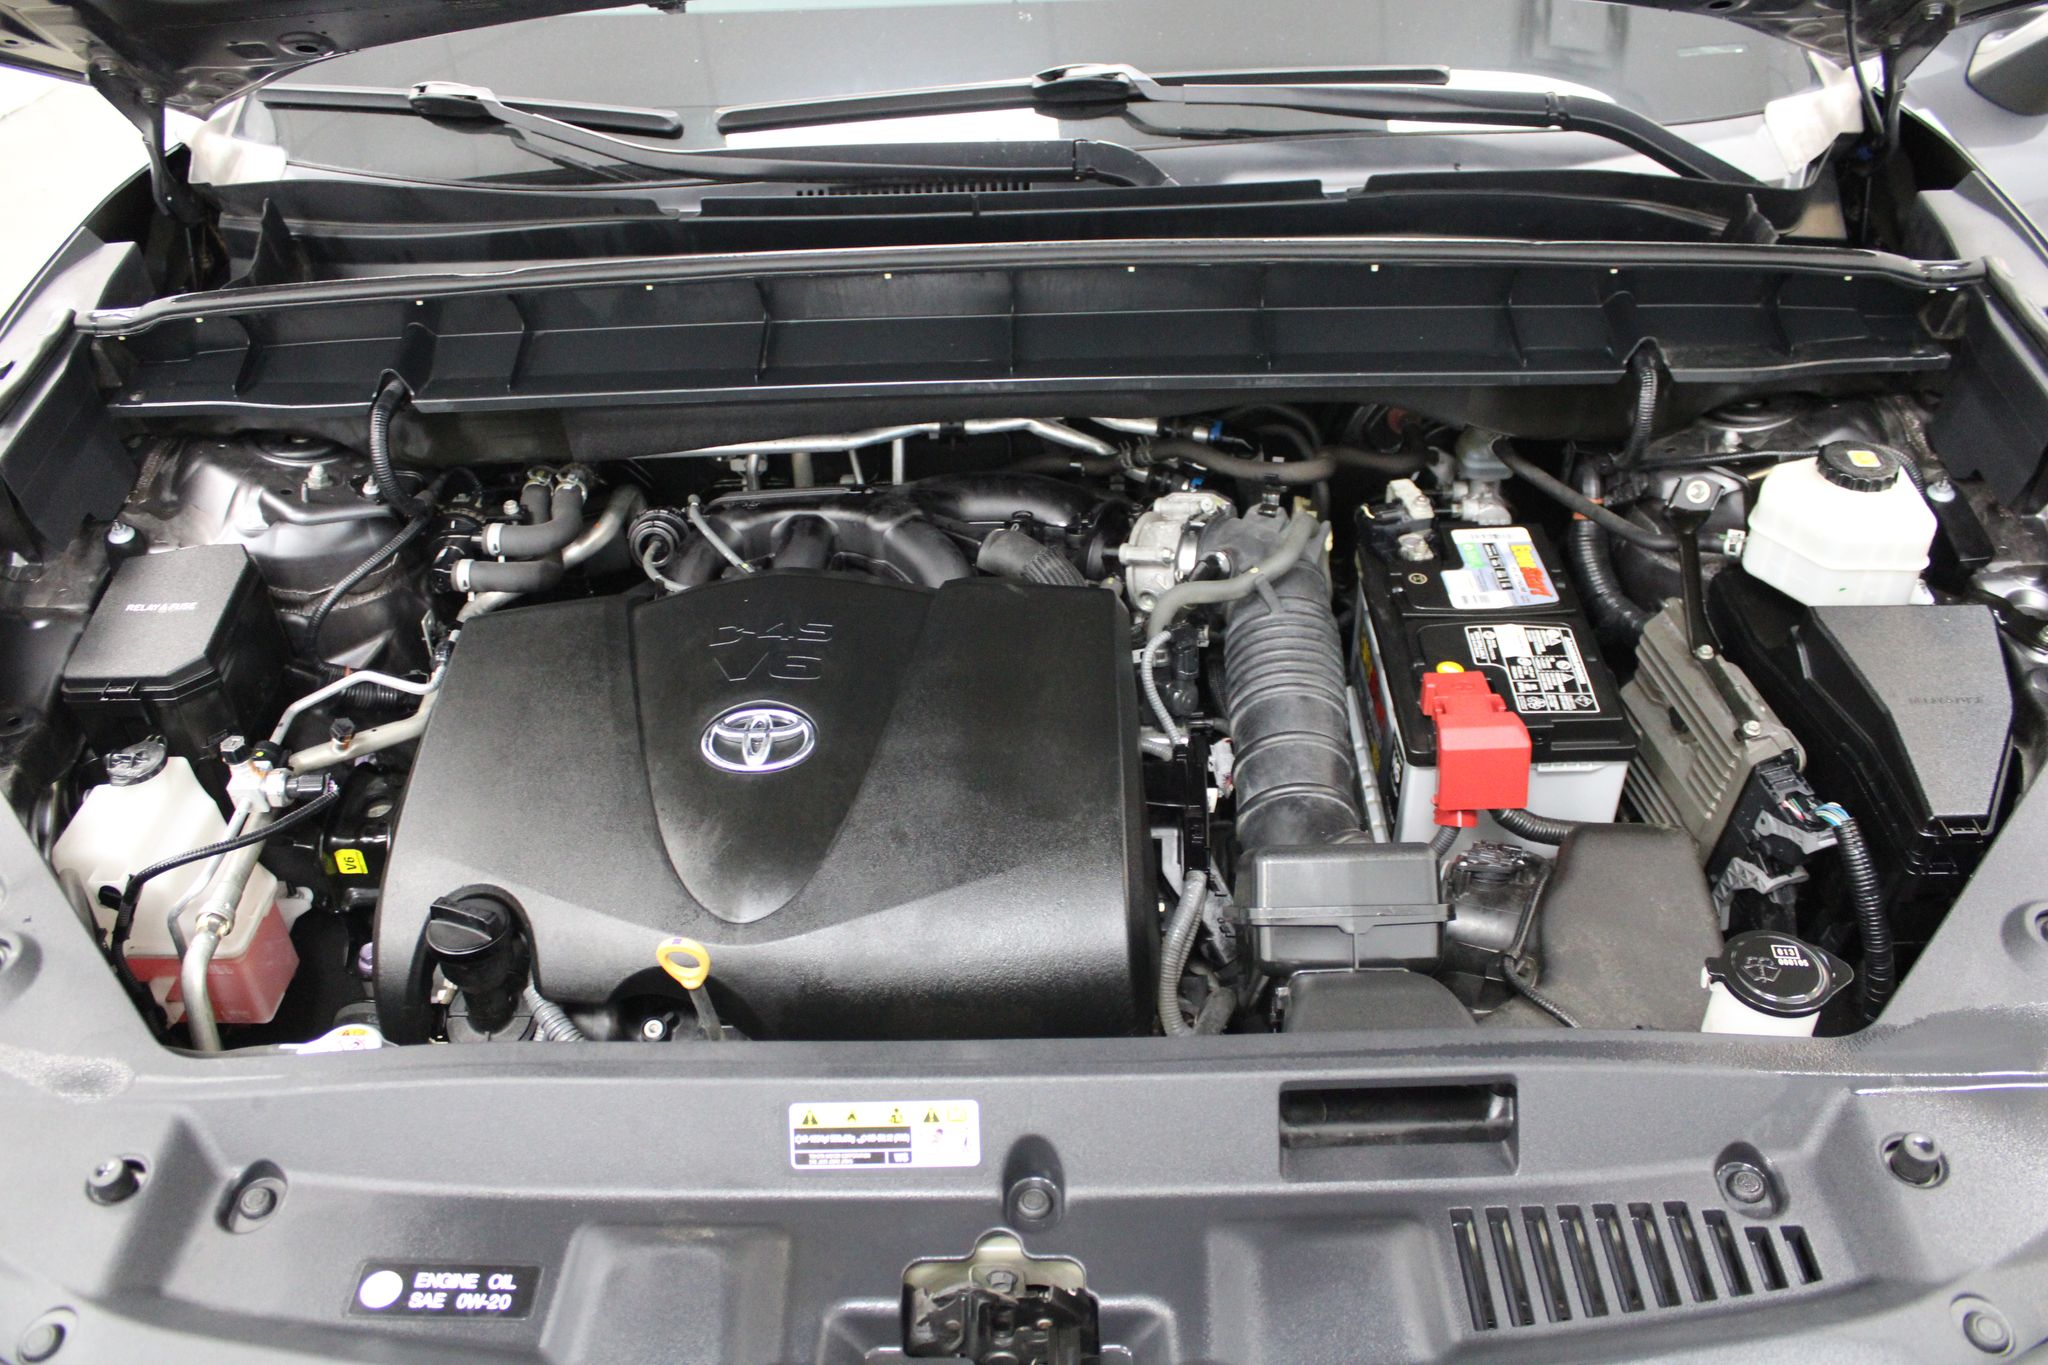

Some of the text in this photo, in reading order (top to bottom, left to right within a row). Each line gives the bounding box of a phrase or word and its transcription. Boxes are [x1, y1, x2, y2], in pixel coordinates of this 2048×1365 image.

[713, 651, 822, 681] V6
[344, 857, 357, 870] V6
[414, 1272, 517, 1290] ENGINE OIL
[408, 1292, 512, 1310] SAE 0W-20
